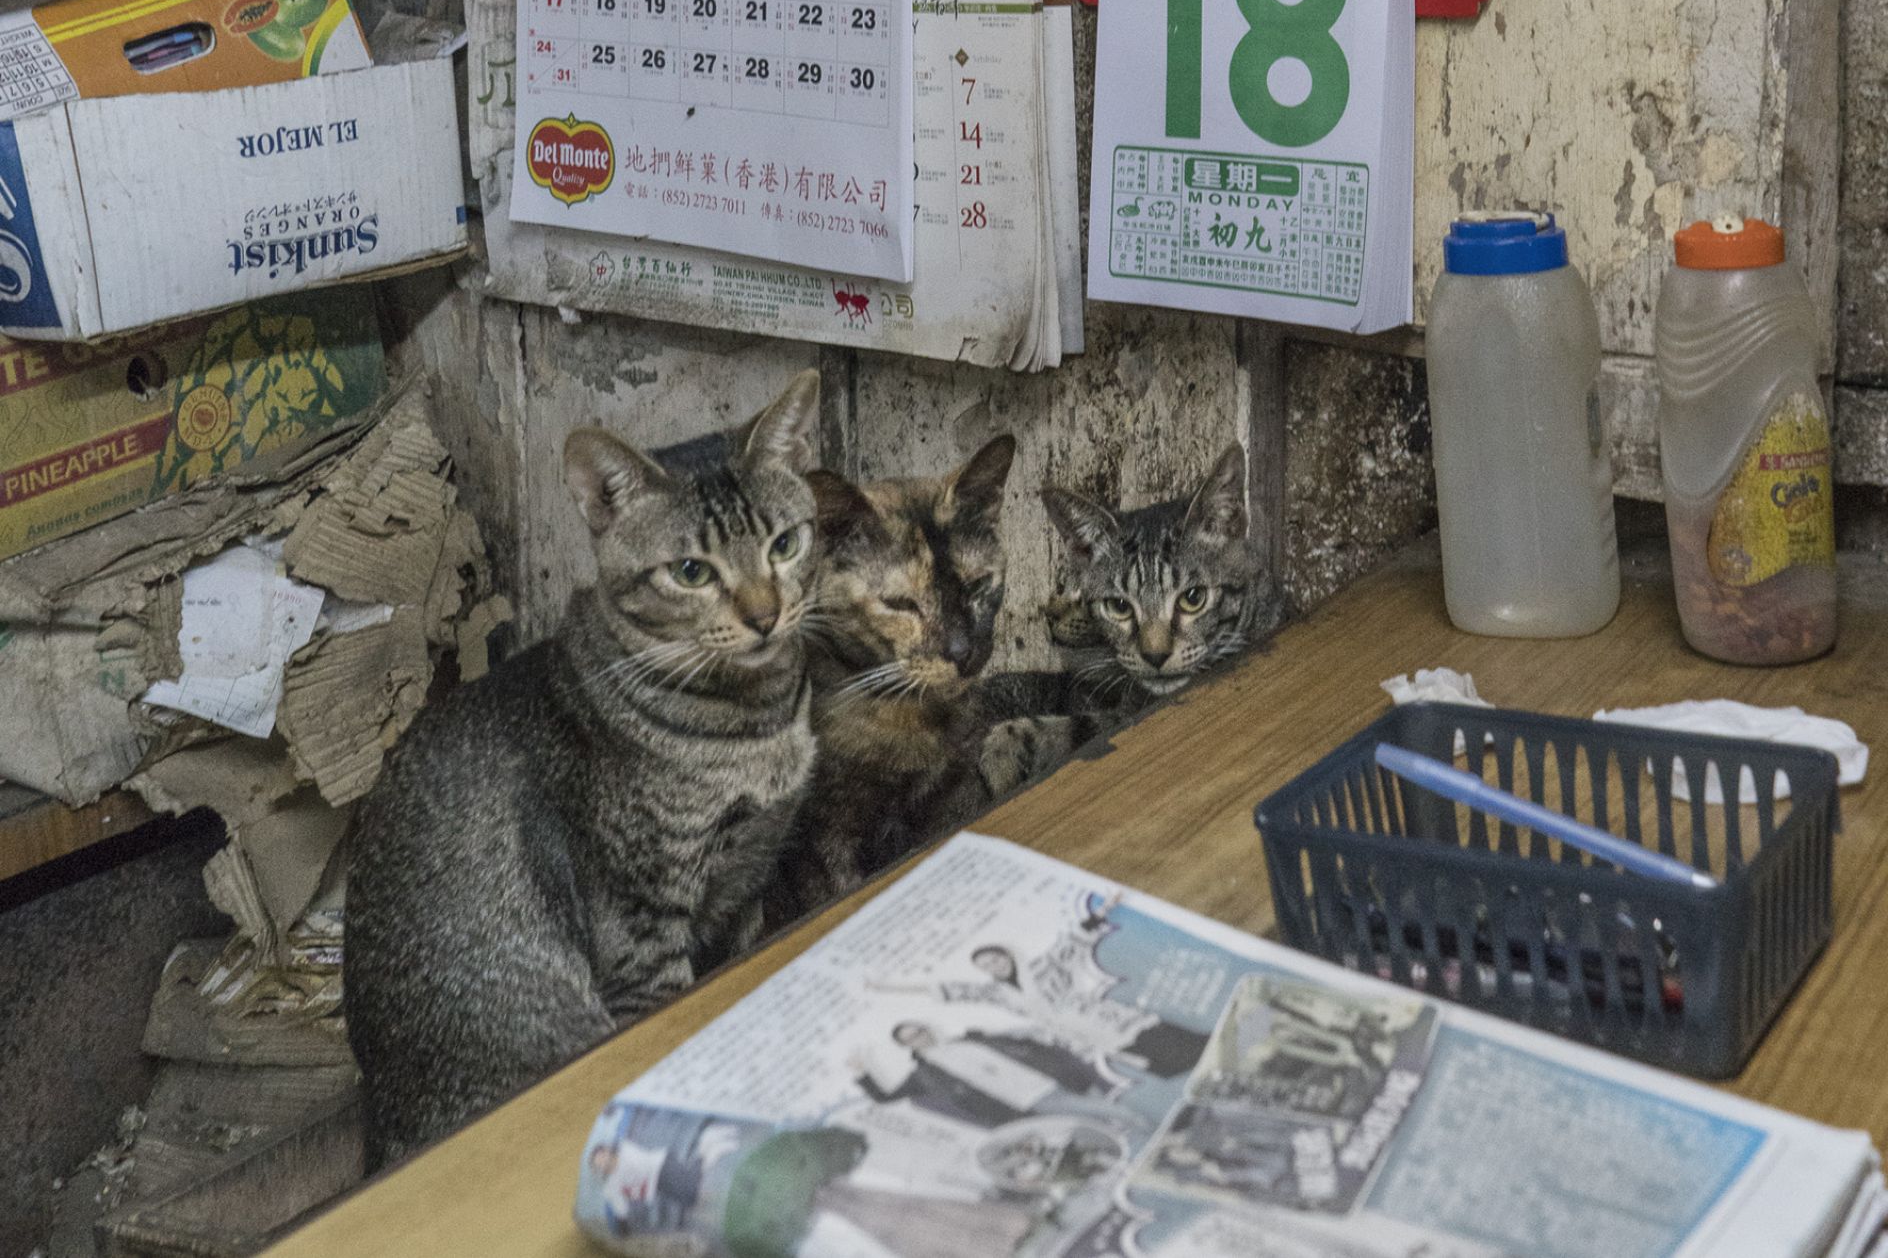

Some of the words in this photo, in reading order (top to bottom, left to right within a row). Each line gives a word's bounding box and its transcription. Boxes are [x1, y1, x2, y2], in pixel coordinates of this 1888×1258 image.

[746, 1, 767, 22] 21
[799, 4, 823, 26] 22
[851, 8, 876, 30] 23
[537, 41, 551, 53] 24
[11, 68, 24, 79] 11
[25, 63, 38, 74] 10
[41, 58, 52, 67] M
[557, 69, 570, 81] 31
[592, 45, 615, 64] 25
[642, 49, 666, 69] 26
[693, 53, 717, 74] 27
[745, 57, 769, 79] 28
[798, 63, 822, 84] 29
[850, 68, 874, 90] 30
[9, 86, 17, 97] 7
[22, 82, 31, 92] 6
[36, 78, 45, 88] 5
[961, 78, 976, 105] 7
[12, 95, 43, 111] COUNT
[238, 126, 323, 158] MEJOR
[329, 119, 358, 144] EL
[960, 121, 982, 149] 14
[534, 139, 557, 165] Del
[560, 142, 609, 171] Monte
[552, 166, 585, 188] Quality
[961, 165, 982, 186] 21
[1191, 159, 1293, 192] 星期一
[1188, 192, 1294, 212] MONDAY
[243, 206, 359, 240] ORANGES
[693, 192, 717, 211] 2723
[722, 196, 746, 215] 7011
[828, 217, 855, 234] 2723
[860, 220, 889, 239] 7066
[961, 201, 987, 229] 28
[228, 212, 379, 280] Sunkist
[1207, 213, 1272, 254] 初九
[713, 265, 744, 280] TAIWAN
[6, 433, 138, 500] PINEAPPLE
